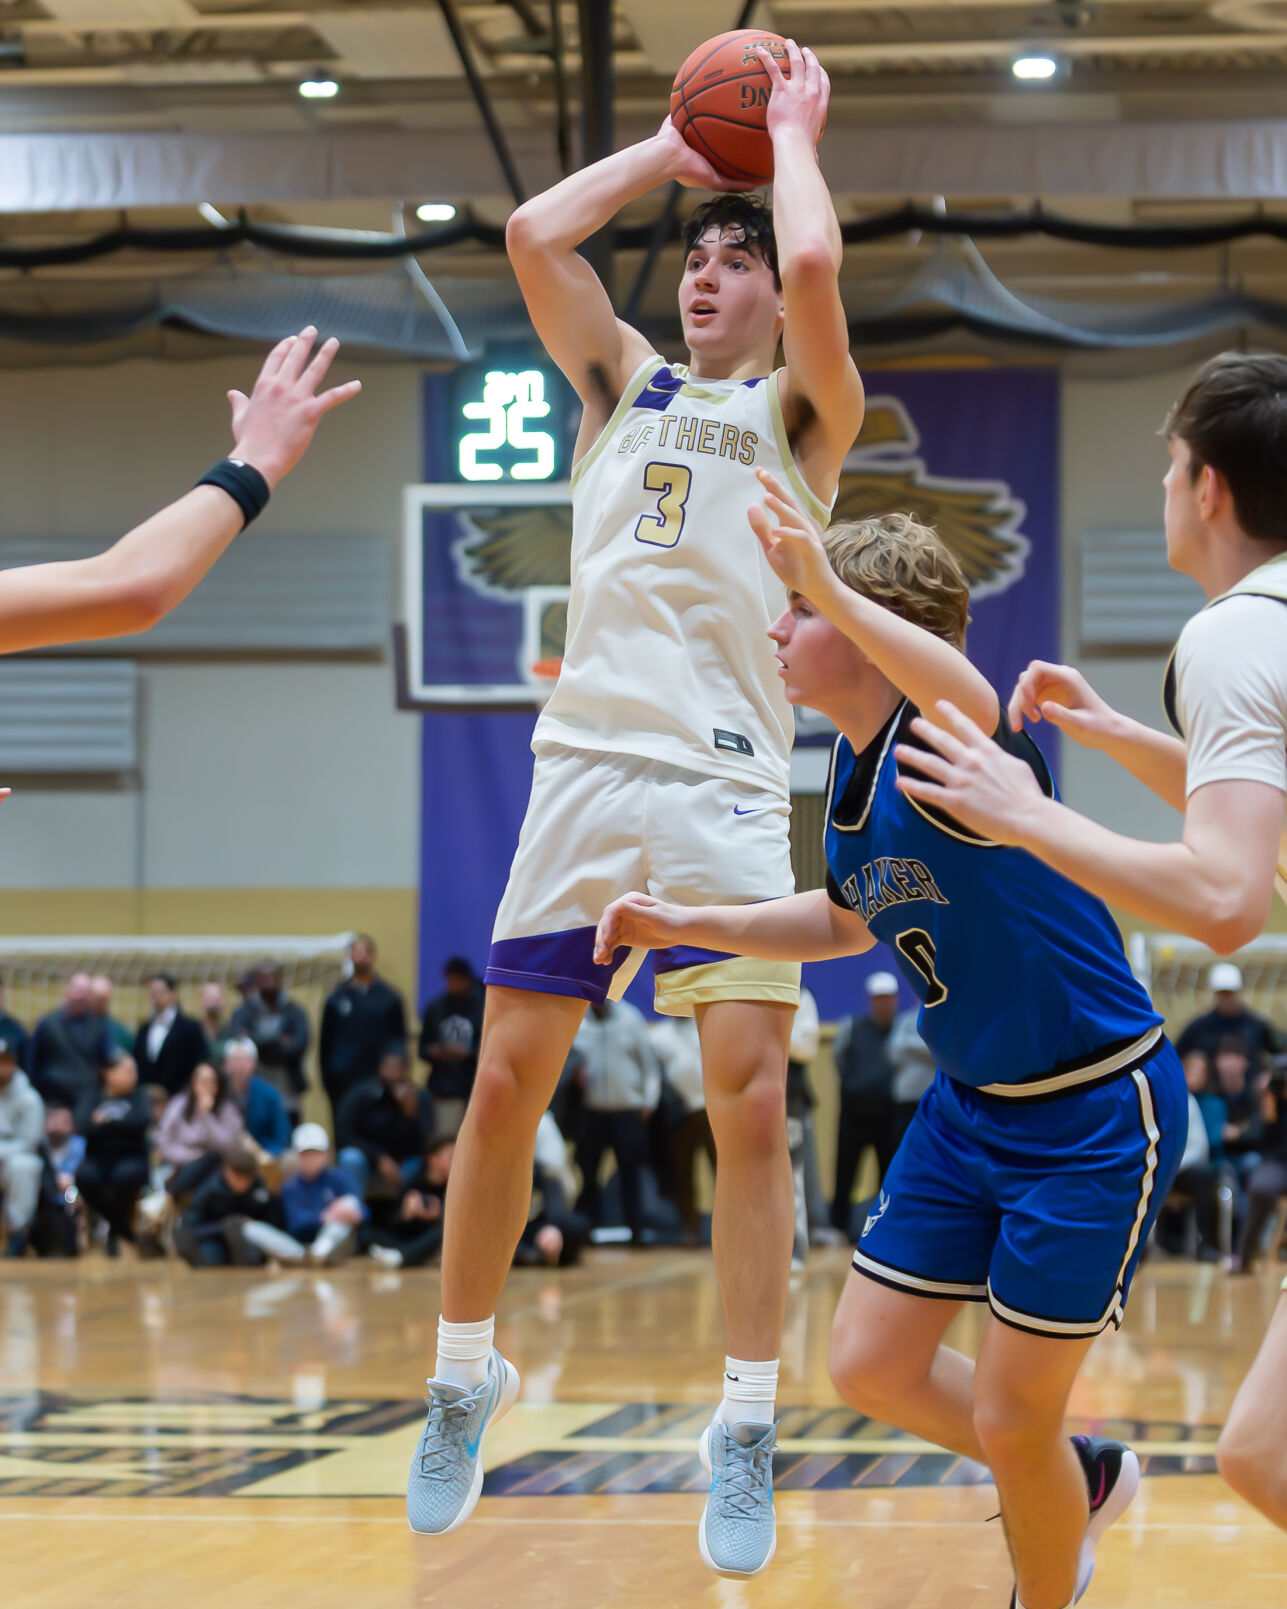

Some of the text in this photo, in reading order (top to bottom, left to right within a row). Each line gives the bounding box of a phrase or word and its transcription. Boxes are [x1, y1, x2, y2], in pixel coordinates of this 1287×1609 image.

[459, 402, 554, 481] 25
[635, 461, 692, 548] 3
[842, 857, 950, 926] HAKER
